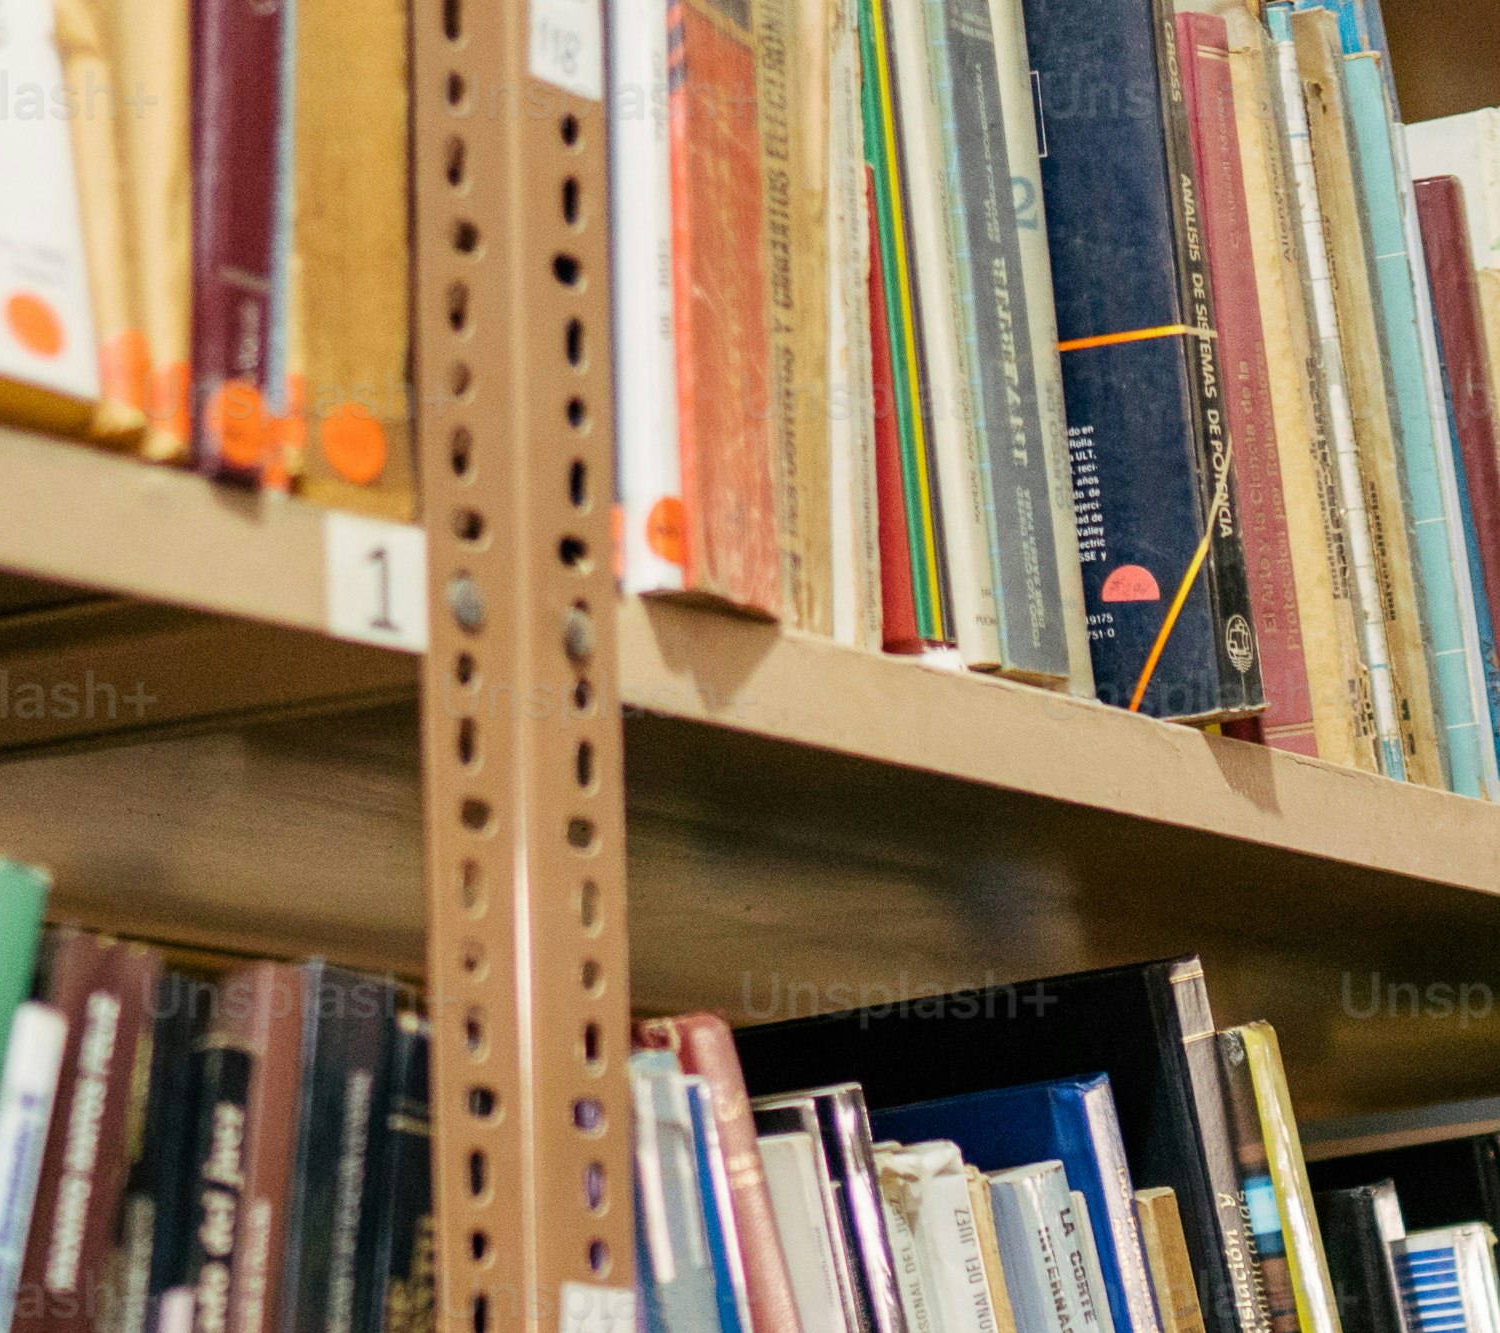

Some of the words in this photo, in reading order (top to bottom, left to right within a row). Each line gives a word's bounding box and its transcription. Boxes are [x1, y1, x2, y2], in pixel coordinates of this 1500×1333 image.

[1160, 19, 1182, 101] GROSS
[1177, 171, 1202, 262] ANALISIS
[1190, 271, 1205, 298] DE
[989, 258, 1029, 466] INVERTIR
[1191, 301, 1218, 399] SISTEMAS
[1205, 407, 1221, 436] DE
[1238, 385, 1253, 414] de
[1240, 423, 1264, 505] Ciencia
[1207, 438, 1235, 538] POTENCIA
[366, 548, 399, 633] 1
[1256, 557, 1276, 605] Arte
[1262, 612, 1278, 633] El
[886, 1193, 908, 1236] JUEZ
[1216, 1189, 1235, 1209] y
[952, 1204, 977, 1249] JUEZ
[898, 1243, 917, 1274] DEL
[963, 1255, 983, 1284] DEL
[1058, 1206, 1076, 1237] LA
[1068, 1249, 1095, 1324] CORTE
